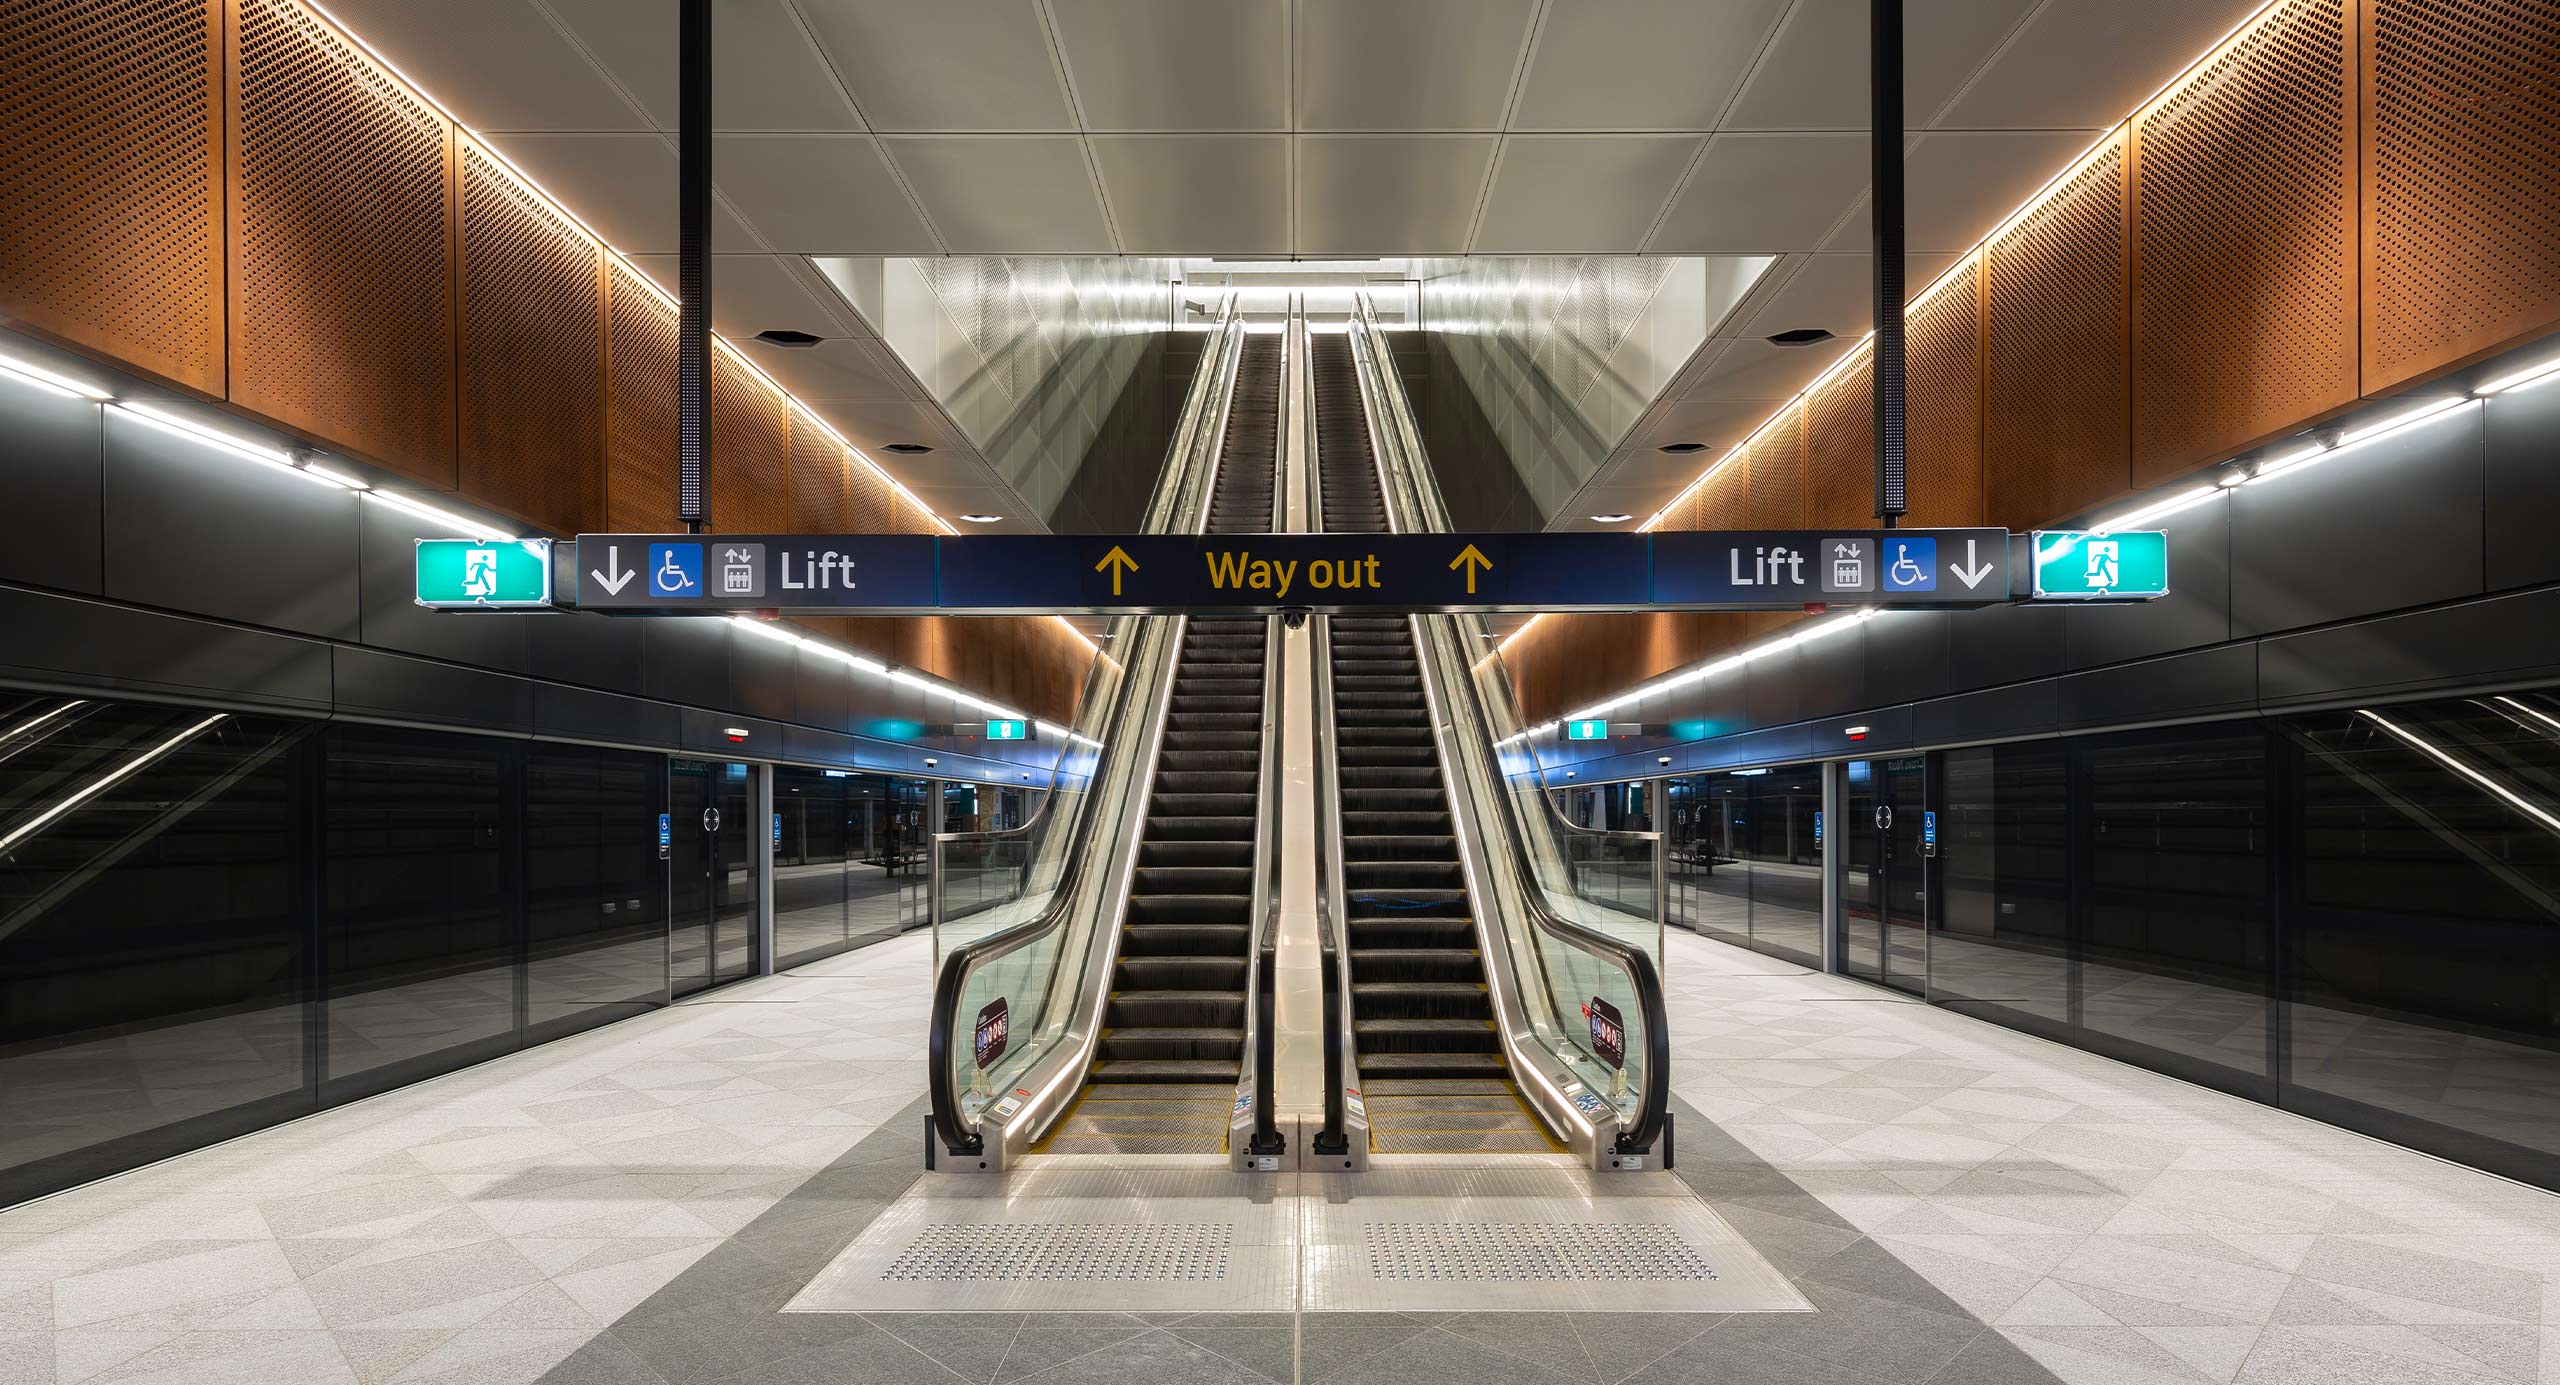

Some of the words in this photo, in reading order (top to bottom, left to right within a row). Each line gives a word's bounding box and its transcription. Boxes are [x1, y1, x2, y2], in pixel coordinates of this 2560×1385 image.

[781, 550, 856, 590] Lift
[1205, 551, 1298, 599] Way
[1308, 554, 1382, 589] out
[1730, 546, 1805, 586] Lift
